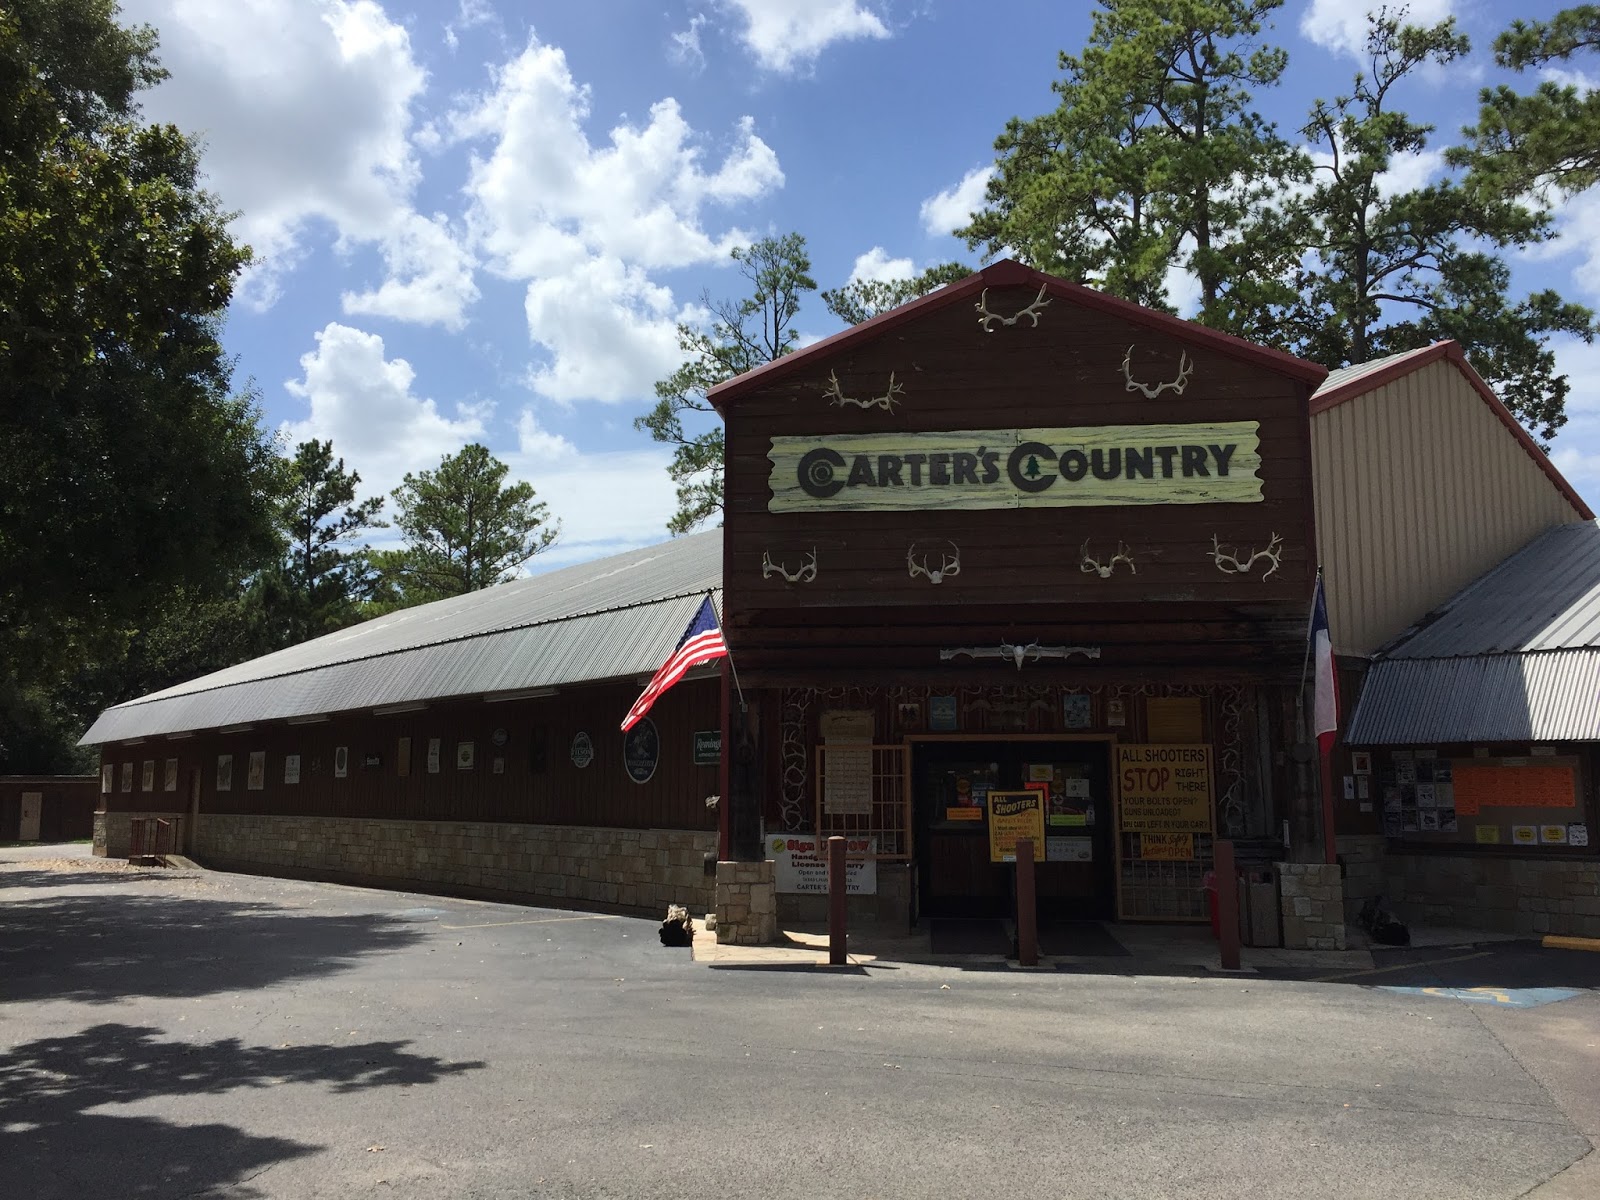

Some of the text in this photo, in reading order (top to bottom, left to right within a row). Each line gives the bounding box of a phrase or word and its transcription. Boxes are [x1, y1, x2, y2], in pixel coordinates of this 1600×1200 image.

[798, 442, 1237, 498] CARTER'S COUNTRY
[1122, 749, 1205, 762] ALL SHOOTERS
[1123, 767, 1205, 792] STOP RIGHT
[1175, 782, 1206, 792] THERE
[1124, 797, 1198, 806] YOUR BOLTS OPEN?
[996, 800, 1037, 815] SHOOTERS
[1124, 808, 1142, 817] GUNS
[1147, 821, 1162, 829] LEFT
[1163, 821, 1170, 829] IN
[1171, 821, 1190, 829] YOUR
[1143, 834, 1167, 844] THINK
[787, 840, 815, 853] Sign
[1168, 847, 1192, 857] OPEN
